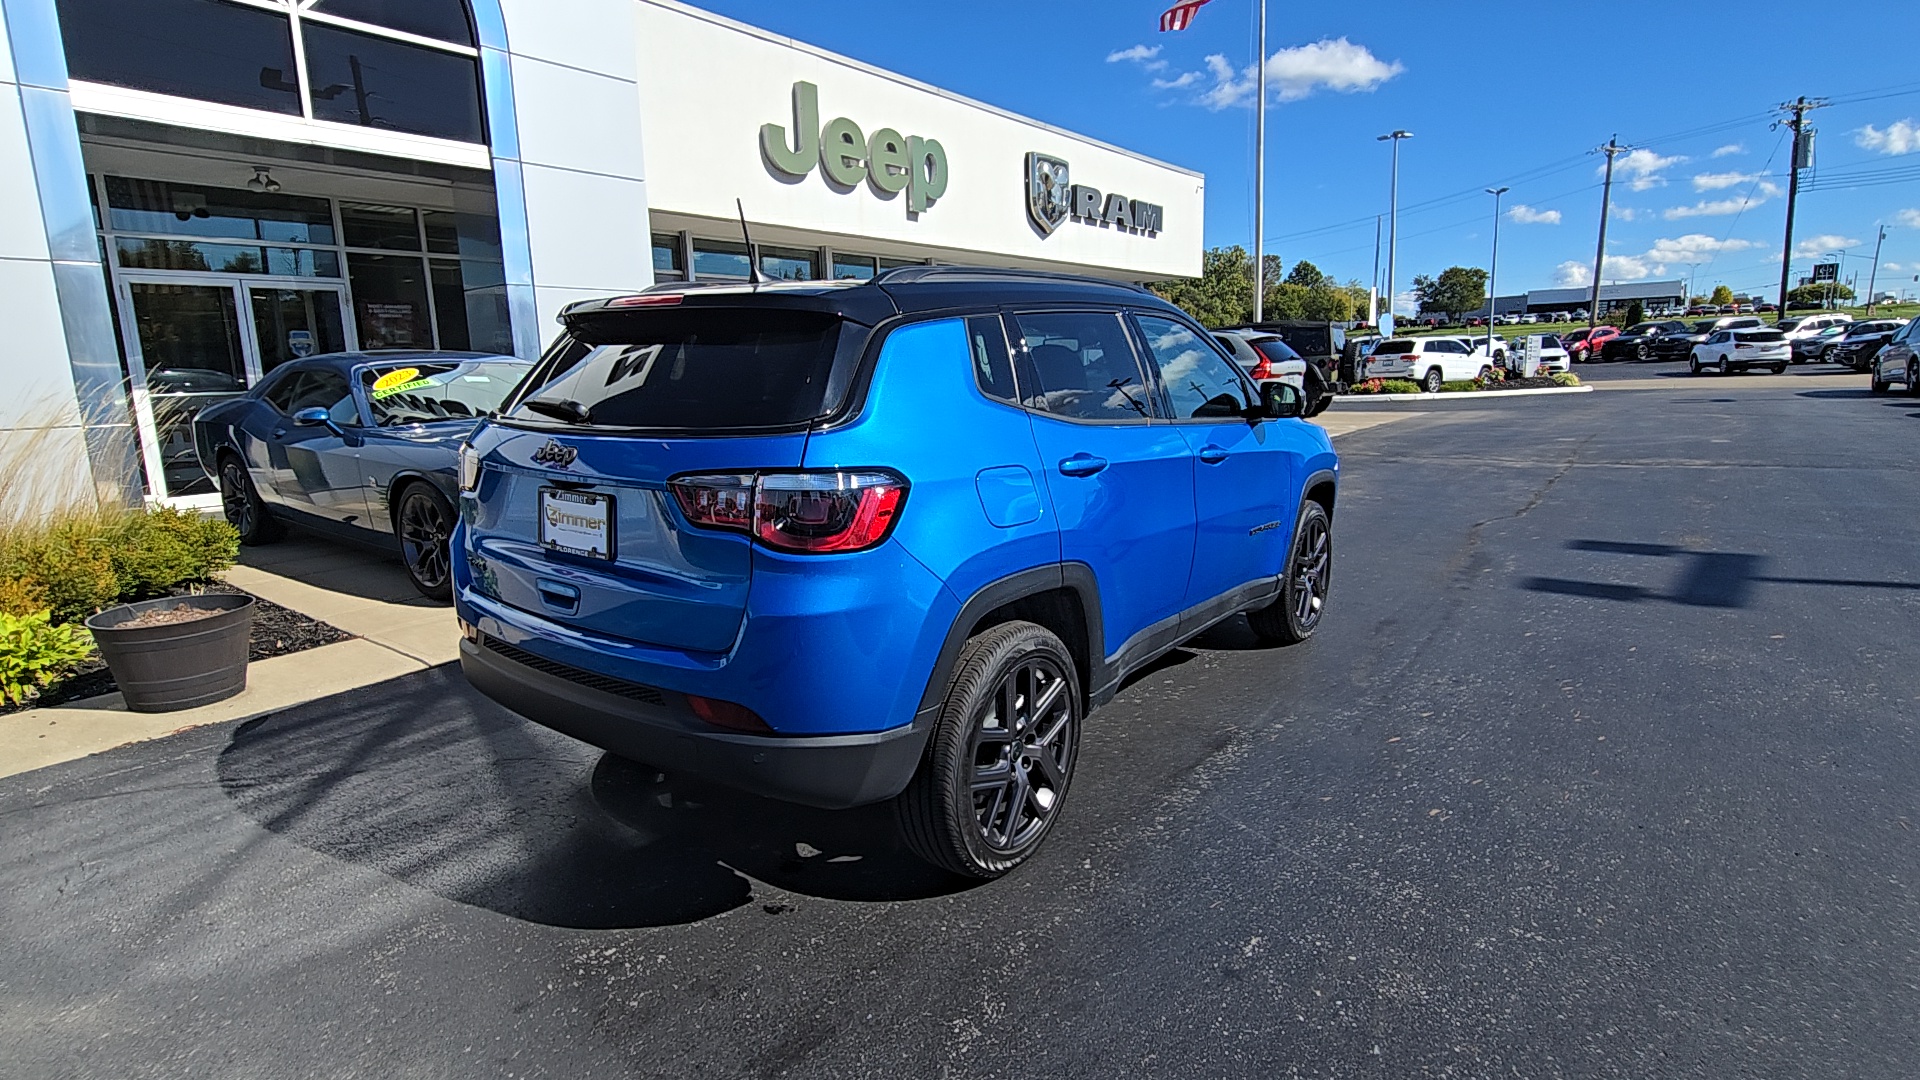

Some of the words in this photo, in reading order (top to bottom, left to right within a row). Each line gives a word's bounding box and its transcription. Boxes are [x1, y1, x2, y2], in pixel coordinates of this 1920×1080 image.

[760, 81, 948, 213] Jeep
[1070, 184, 1163, 232] RAM
[382, 370, 412, 387] 2023
[375, 380, 430, 398] CERTIFIED
[537, 439, 577, 466] Jeep
[555, 490, 588, 504] Zimmer
[556, 546, 589, 557] FLORENCE
